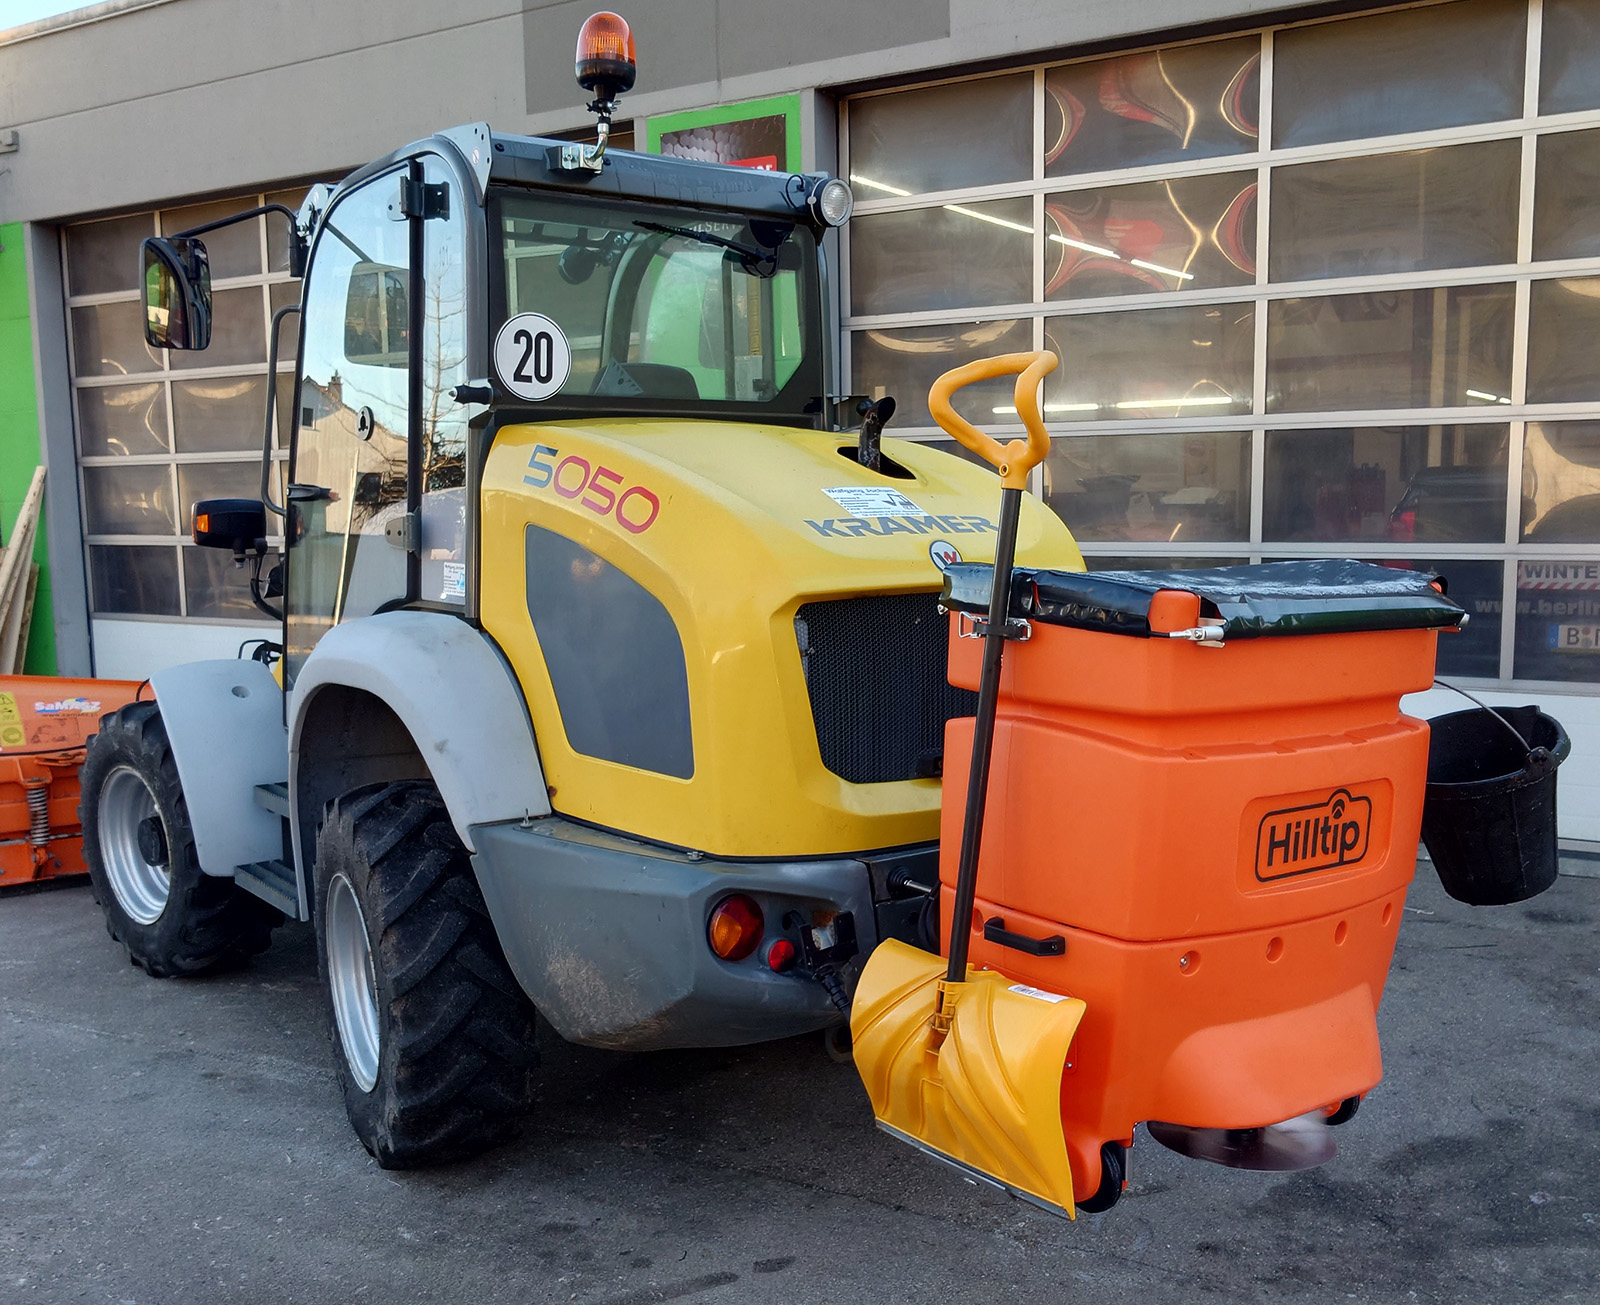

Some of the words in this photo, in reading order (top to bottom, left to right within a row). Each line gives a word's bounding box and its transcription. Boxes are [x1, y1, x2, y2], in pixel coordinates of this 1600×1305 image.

[513, 329, 554, 384] 20
[523, 444, 660, 534] 5050
[803, 515, 999, 538] KRAMER
[1267, 800, 1360, 867] Hilltip
